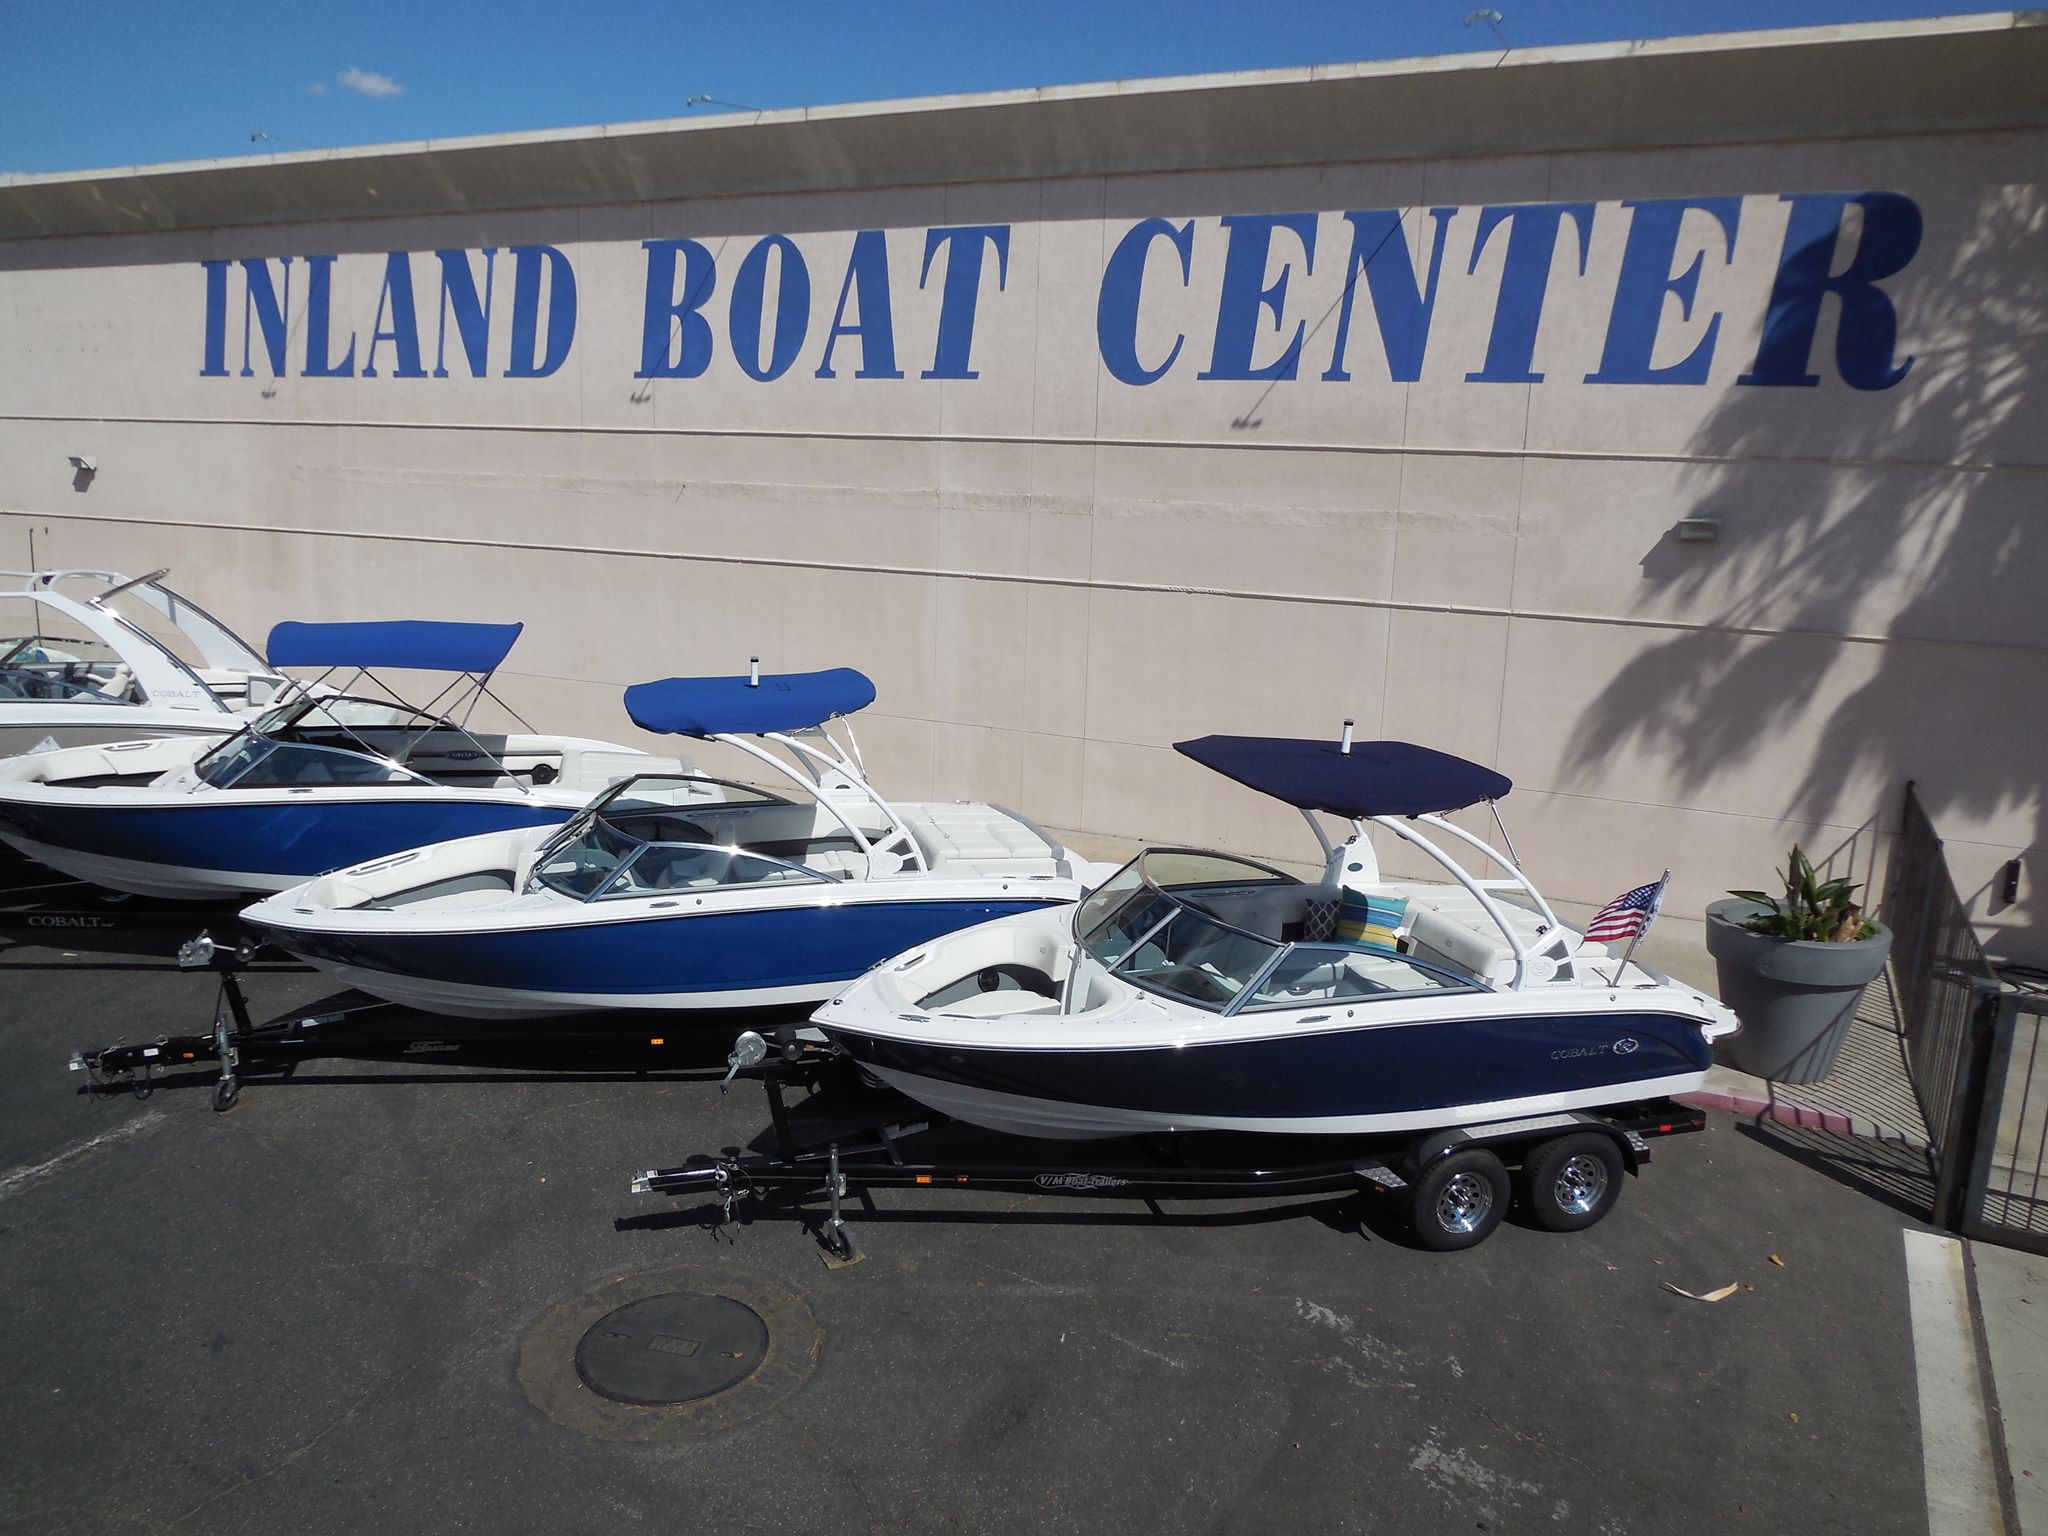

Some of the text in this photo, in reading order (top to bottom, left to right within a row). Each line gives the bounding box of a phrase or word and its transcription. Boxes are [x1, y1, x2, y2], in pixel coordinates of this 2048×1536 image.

[199, 189, 1926, 391] INLAND BOAT CENTER
[152, 689, 201, 698] COBALT
[28, 915, 101, 928] COBALT
[1550, 1044, 1608, 1060] COBALT
